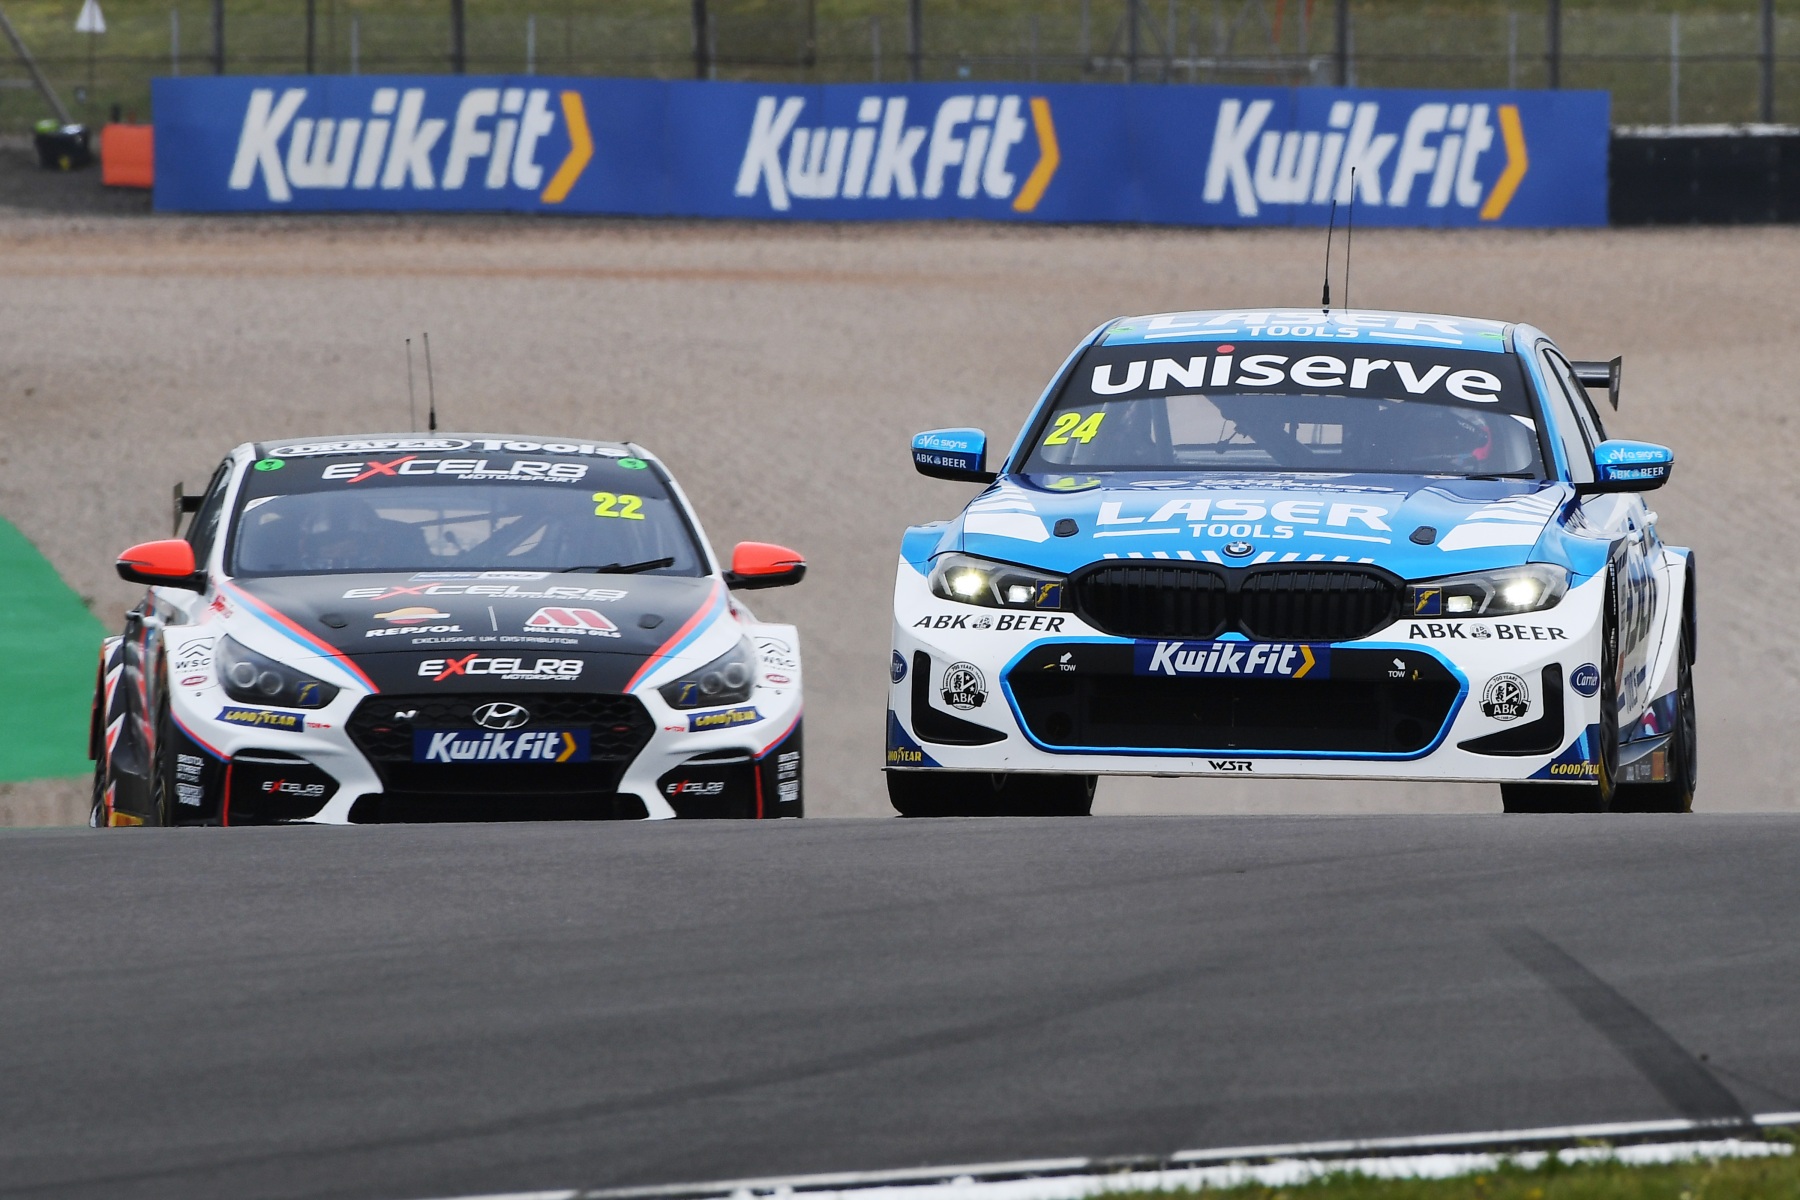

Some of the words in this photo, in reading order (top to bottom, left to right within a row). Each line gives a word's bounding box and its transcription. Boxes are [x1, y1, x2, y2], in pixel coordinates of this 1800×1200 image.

[1246, 326, 1359, 339] TOOLS
[1043, 412, 1106, 446] 24
[916, 453, 933, 464] ABK
[942, 456, 967, 469] BEER
[322, 456, 589, 483] EXCELR8
[1609, 469, 1631, 480] ABK
[1640, 466, 1664, 477] BEER
[457, 473, 581, 484] MOTORSPORT
[592, 491, 645, 520] 22
[1096, 499, 1393, 532] LASER
[1188, 523, 1294, 539] TOOLS
[342, 583, 629, 601] EXCELR8
[365, 624, 463, 638] REPSOL
[913, 614, 972, 629] ABK
[995, 614, 1065, 633] BEER
[523, 626, 586, 636] MILLERS
[588, 629, 622, 638] OILS
[1409, 623, 1468, 640] ABK
[1494, 624, 1569, 641] BEER
[412, 635, 476, 645] EXCLUSIVE
[479, 635, 498, 643] UK
[500, 635, 579, 645] DISTRIBUTOR
[418, 653, 584, 682] EXCELR8
[1059, 664, 1077, 672] TOW
[1388, 670, 1406, 678] TOW
[1576, 672, 1598, 687] Carrier
[953, 692, 976, 705] ABK
[1493, 703, 1519, 715] ABK
[225, 710, 296, 726] GOODYEAR
[1208, 760, 1253, 772] WSR
